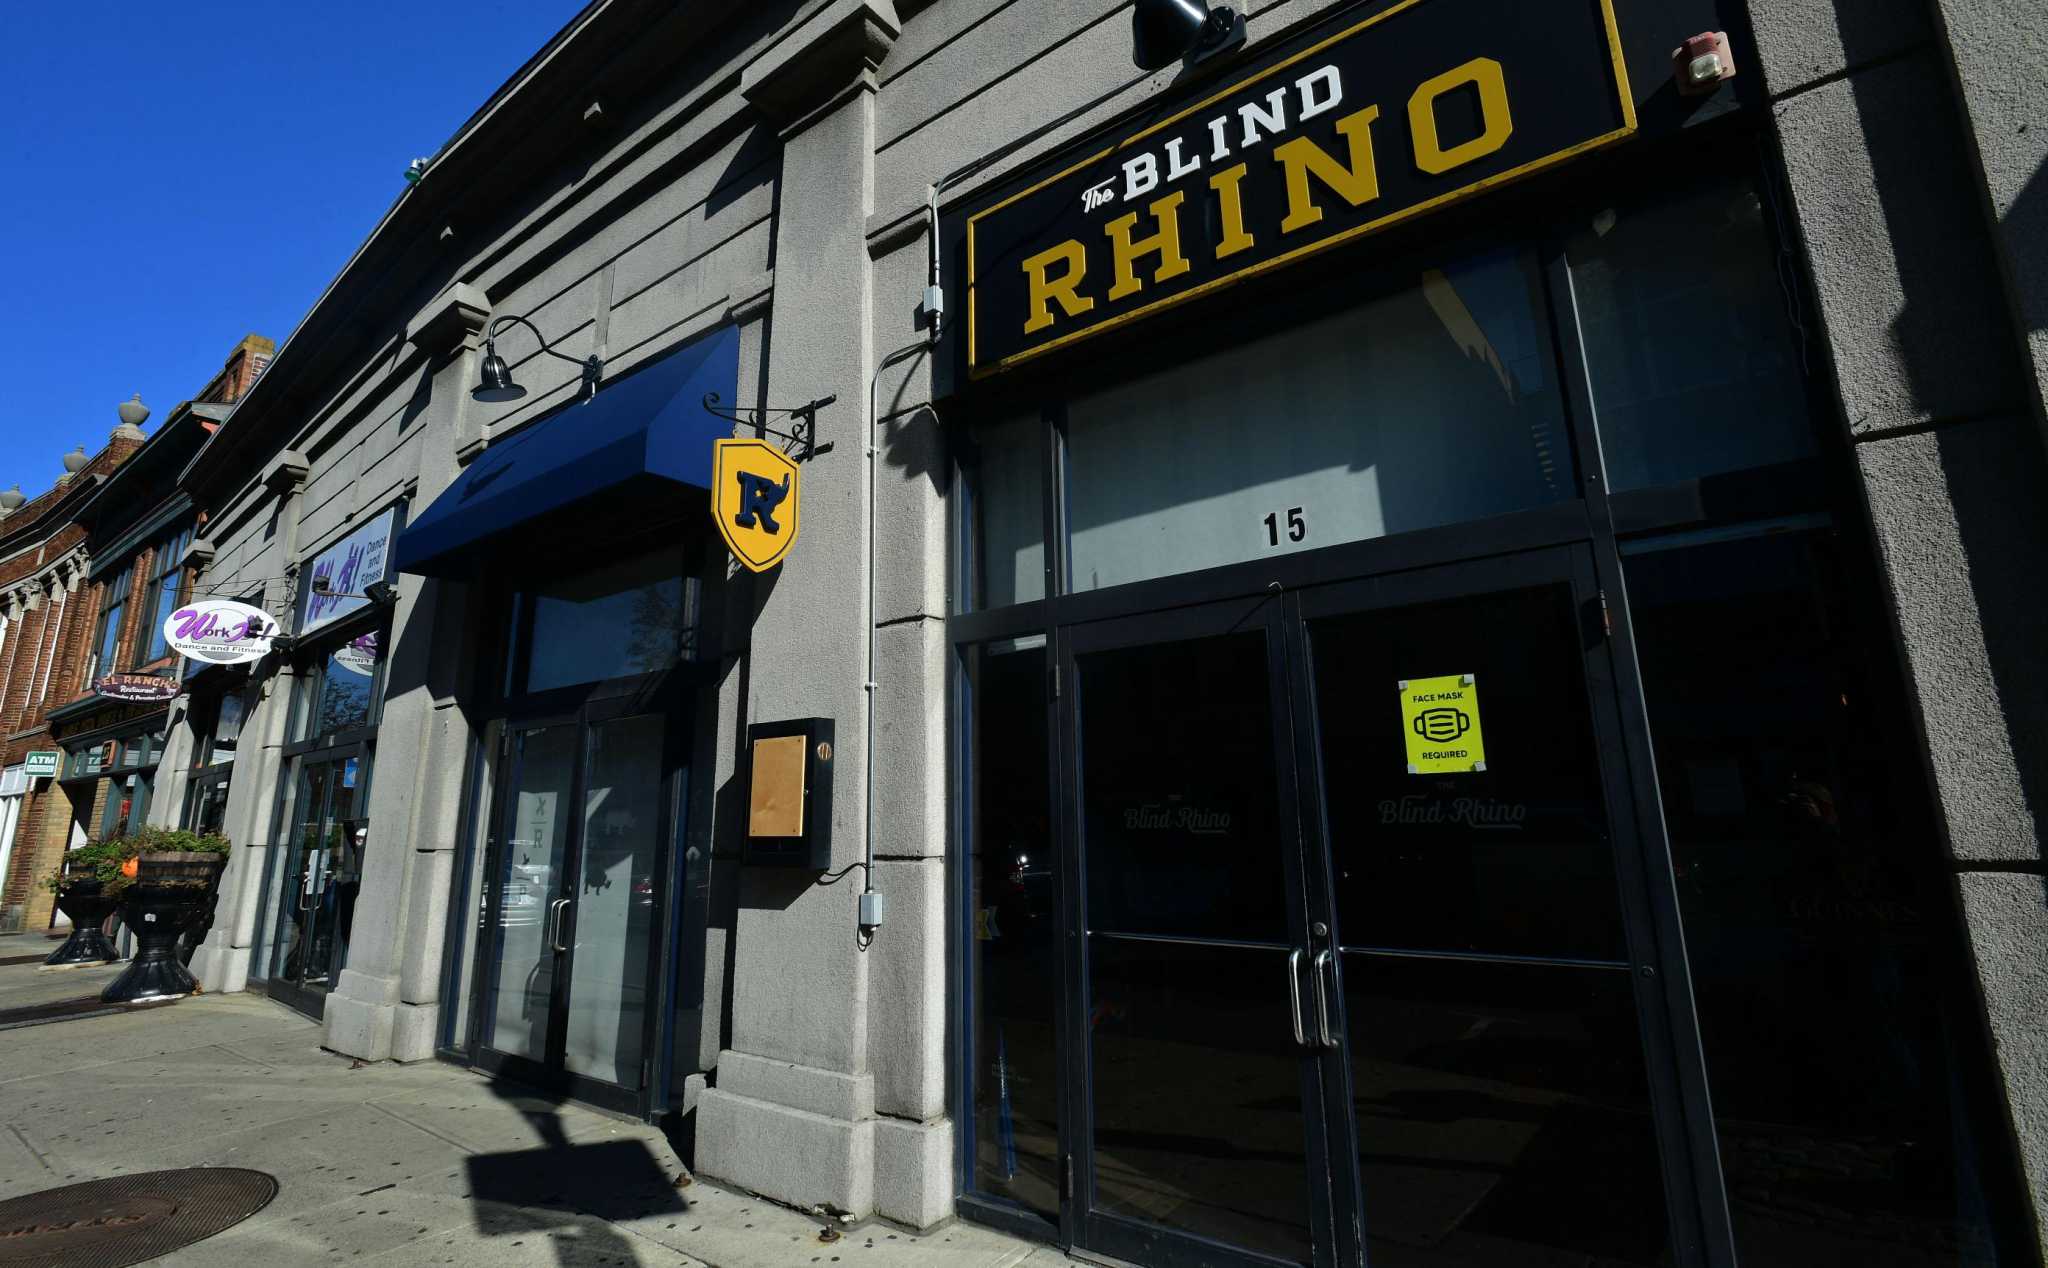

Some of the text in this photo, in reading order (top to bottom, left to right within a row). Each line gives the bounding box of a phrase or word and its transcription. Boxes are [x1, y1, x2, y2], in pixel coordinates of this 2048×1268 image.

[1081, 64, 1343, 213] The BLIND
[1022, 56, 1513, 335] RHINO
[1264, 506, 1306, 546] 15
[367, 535, 387, 555] Dance
[368, 553, 381, 569] and
[360, 568, 384, 588] Fitness
[173, 609, 275, 643] Work I!
[174, 642, 208, 651] Dance
[232, 646, 267, 654] Fitness
[103, 675, 178, 690] EL RANCHO
[1412, 691, 1464, 703] FACE MASK
[28, 755, 55, 765] ATM
[1422, 750, 1468, 760] REQUIRED
[1124, 800, 1231, 833] Blind Rhino
[1376, 793, 1528, 831] Blind Rhino
